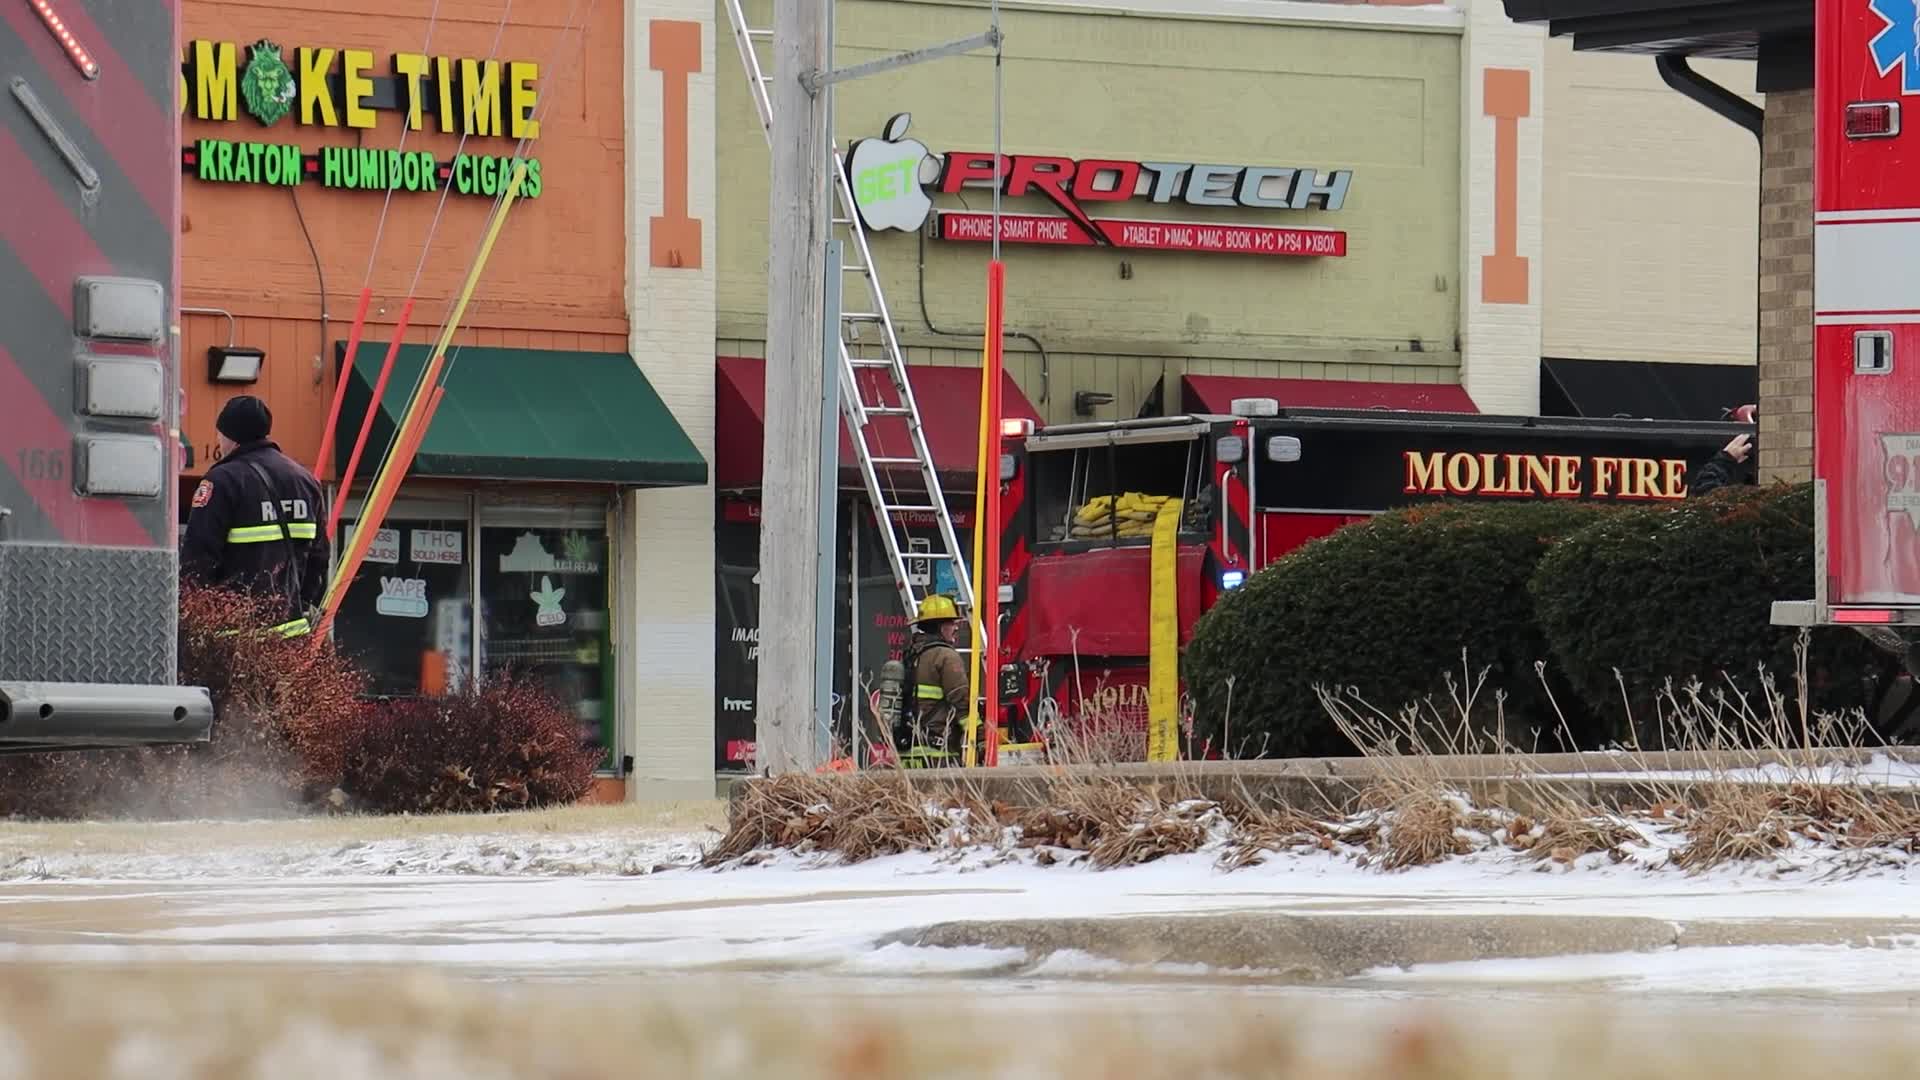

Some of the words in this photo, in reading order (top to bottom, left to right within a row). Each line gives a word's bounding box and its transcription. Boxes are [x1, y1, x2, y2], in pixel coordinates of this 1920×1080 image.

[393, 53, 540, 138] TIME
[199, 140, 301, 185] KRATOM
[323, 147, 437, 191] HUMIDOR
[455, 153, 543, 198] CIGARS
[942, 152, 1353, 246] PROTECH
[960, 218, 993, 236] IPHONE
[1003, 219, 1035, 238] SMART
[1037, 221, 1068, 239] PHONE
[1128, 226, 1161, 245] TABLET
[1170, 228, 1193, 246] IMAC
[1202, 230, 1223, 247] MAC
[1226, 231, 1251, 249] BOOK
[1261, 233, 1274, 250] PC
[1283, 234, 1301, 251] PS4
[1311, 235, 1336, 252] XBOX
[1403, 451, 1583, 497] MOLINE
[1592, 456, 1689, 499] FIRE
[413, 551, 435, 560] SOLD
[437, 552, 460, 561] HERE
[418, 531, 456, 548] THC
[382, 579, 426, 599] VAPE
[724, 697, 752, 711] htc
